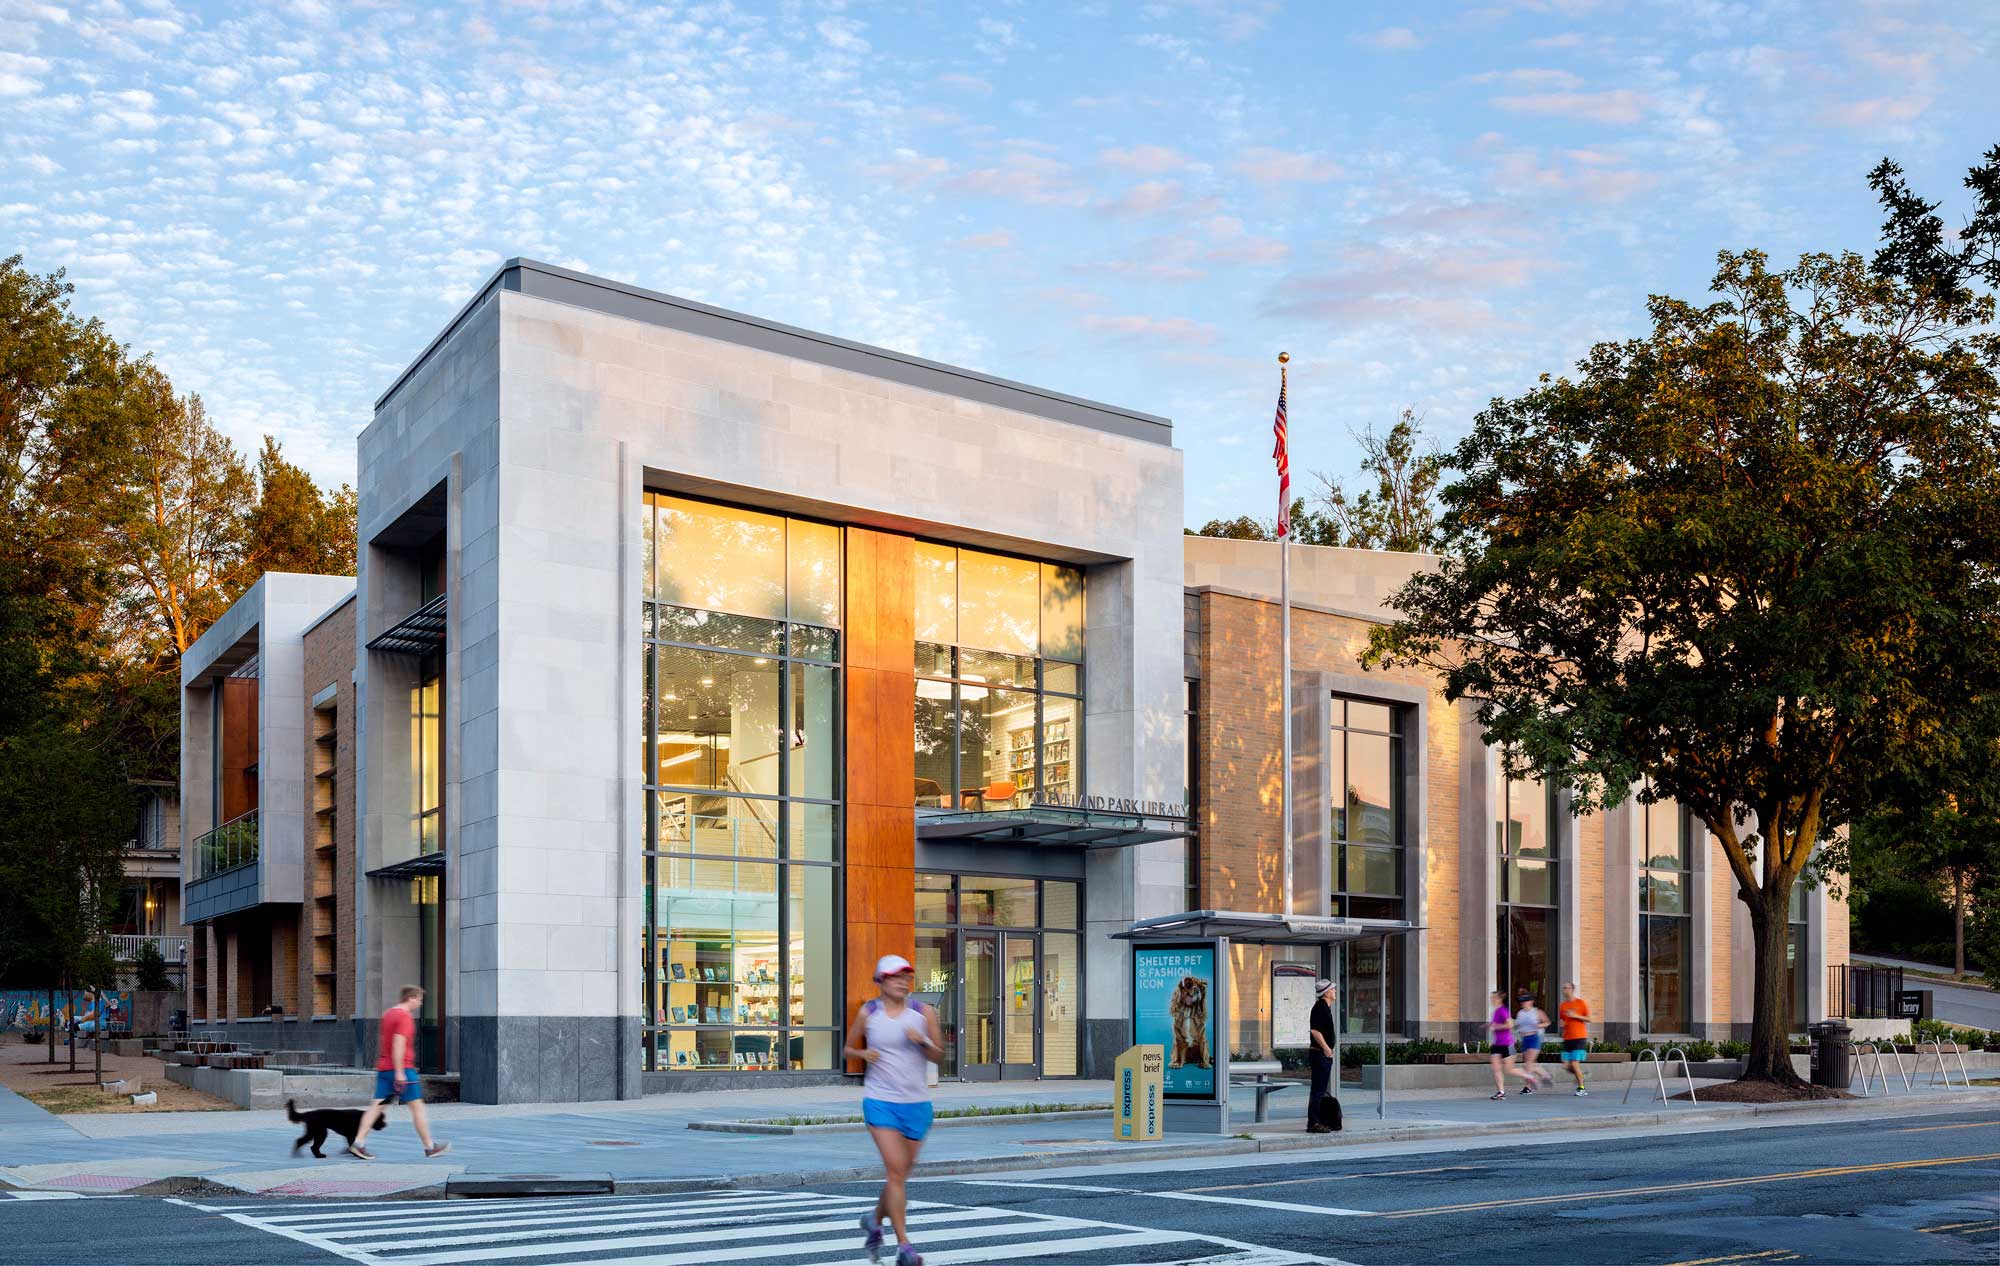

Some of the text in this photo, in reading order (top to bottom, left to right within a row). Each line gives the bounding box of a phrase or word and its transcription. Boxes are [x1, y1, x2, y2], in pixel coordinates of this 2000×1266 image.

[1108, 797, 1139, 813] PARK
[1141, 800, 1189, 817] LIBRARY
[1139, 955, 1202, 967] SHELTER PET
[1139, 967, 1192, 978] & FASHION
[1139, 979, 1164, 989] ICON
[1898, 1001, 1919, 1015] lbrary
[1144, 1063, 1160, 1073] brief
[1123, 1070, 1132, 1117] express
[1148, 1084, 1156, 1134] express
